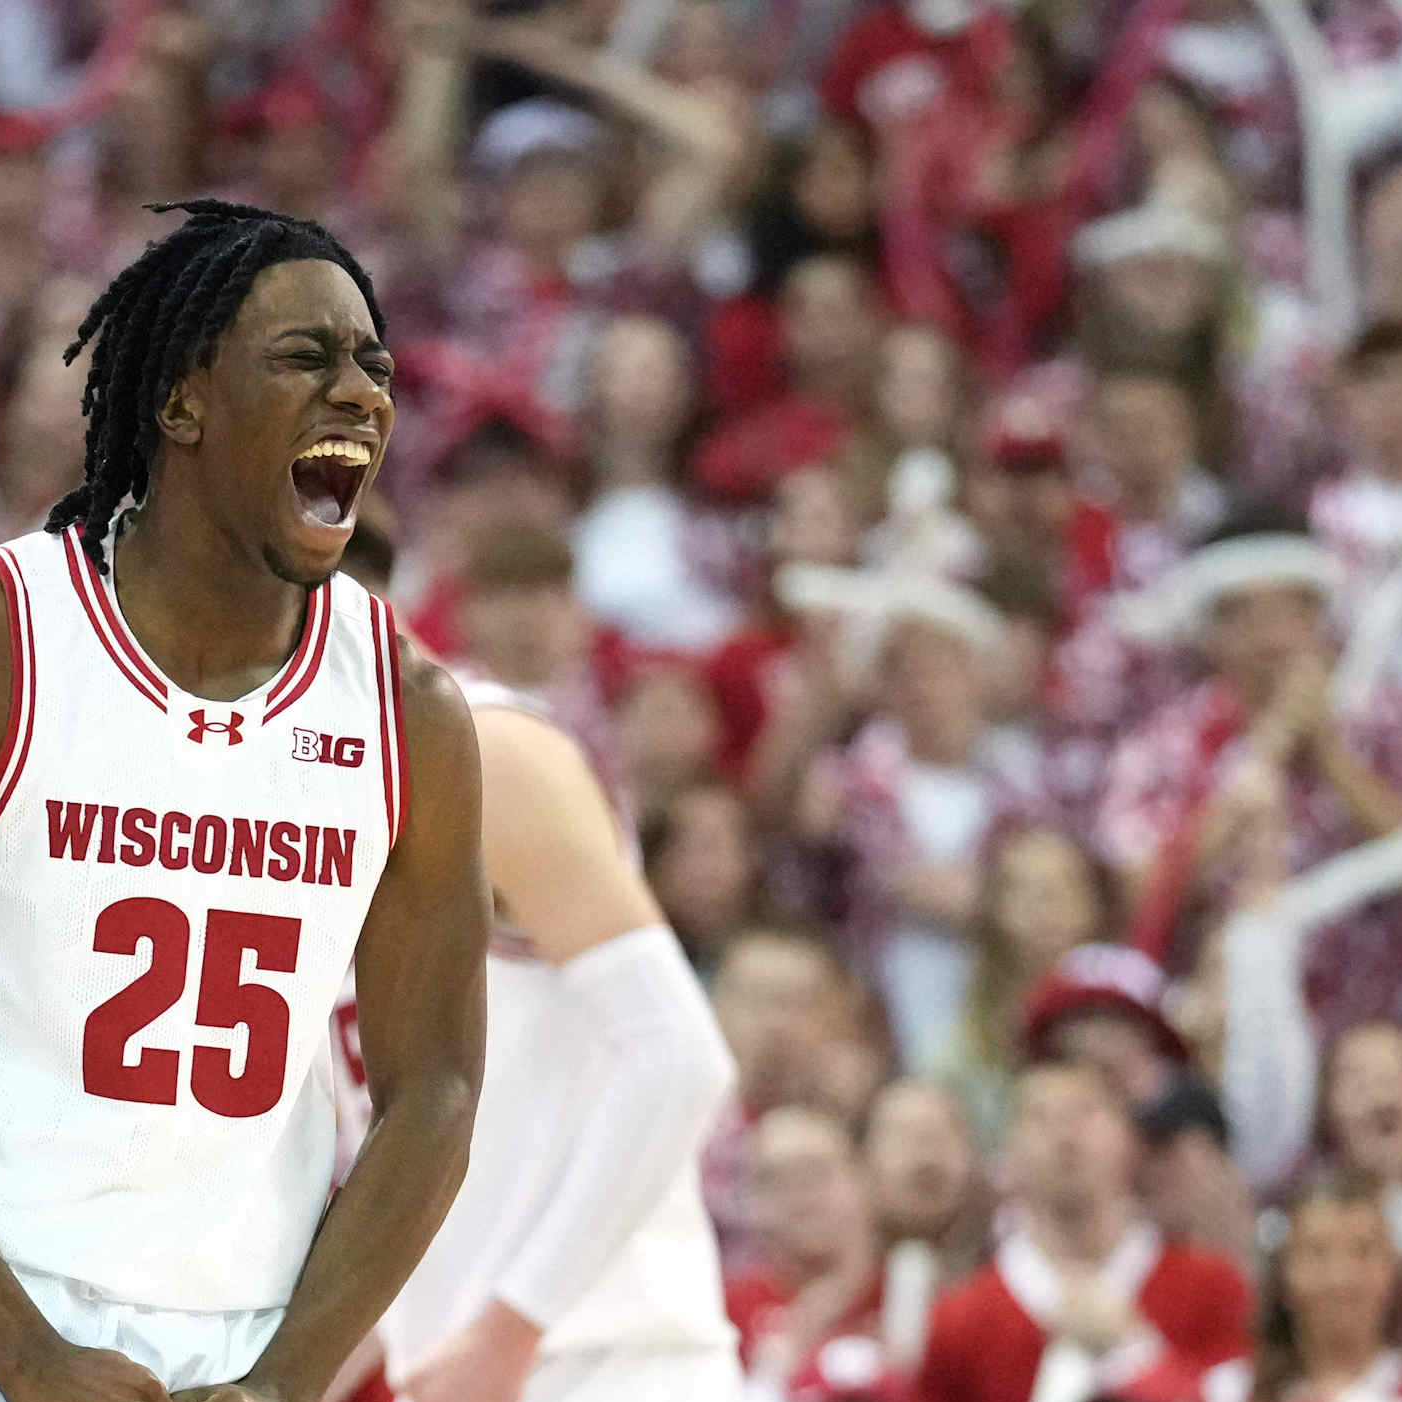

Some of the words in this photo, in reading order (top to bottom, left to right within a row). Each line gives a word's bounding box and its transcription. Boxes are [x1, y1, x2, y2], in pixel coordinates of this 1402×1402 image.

[292, 727, 365, 768] BIG
[46, 799, 356, 887] WISCONSIN
[83, 897, 302, 1118] 25
